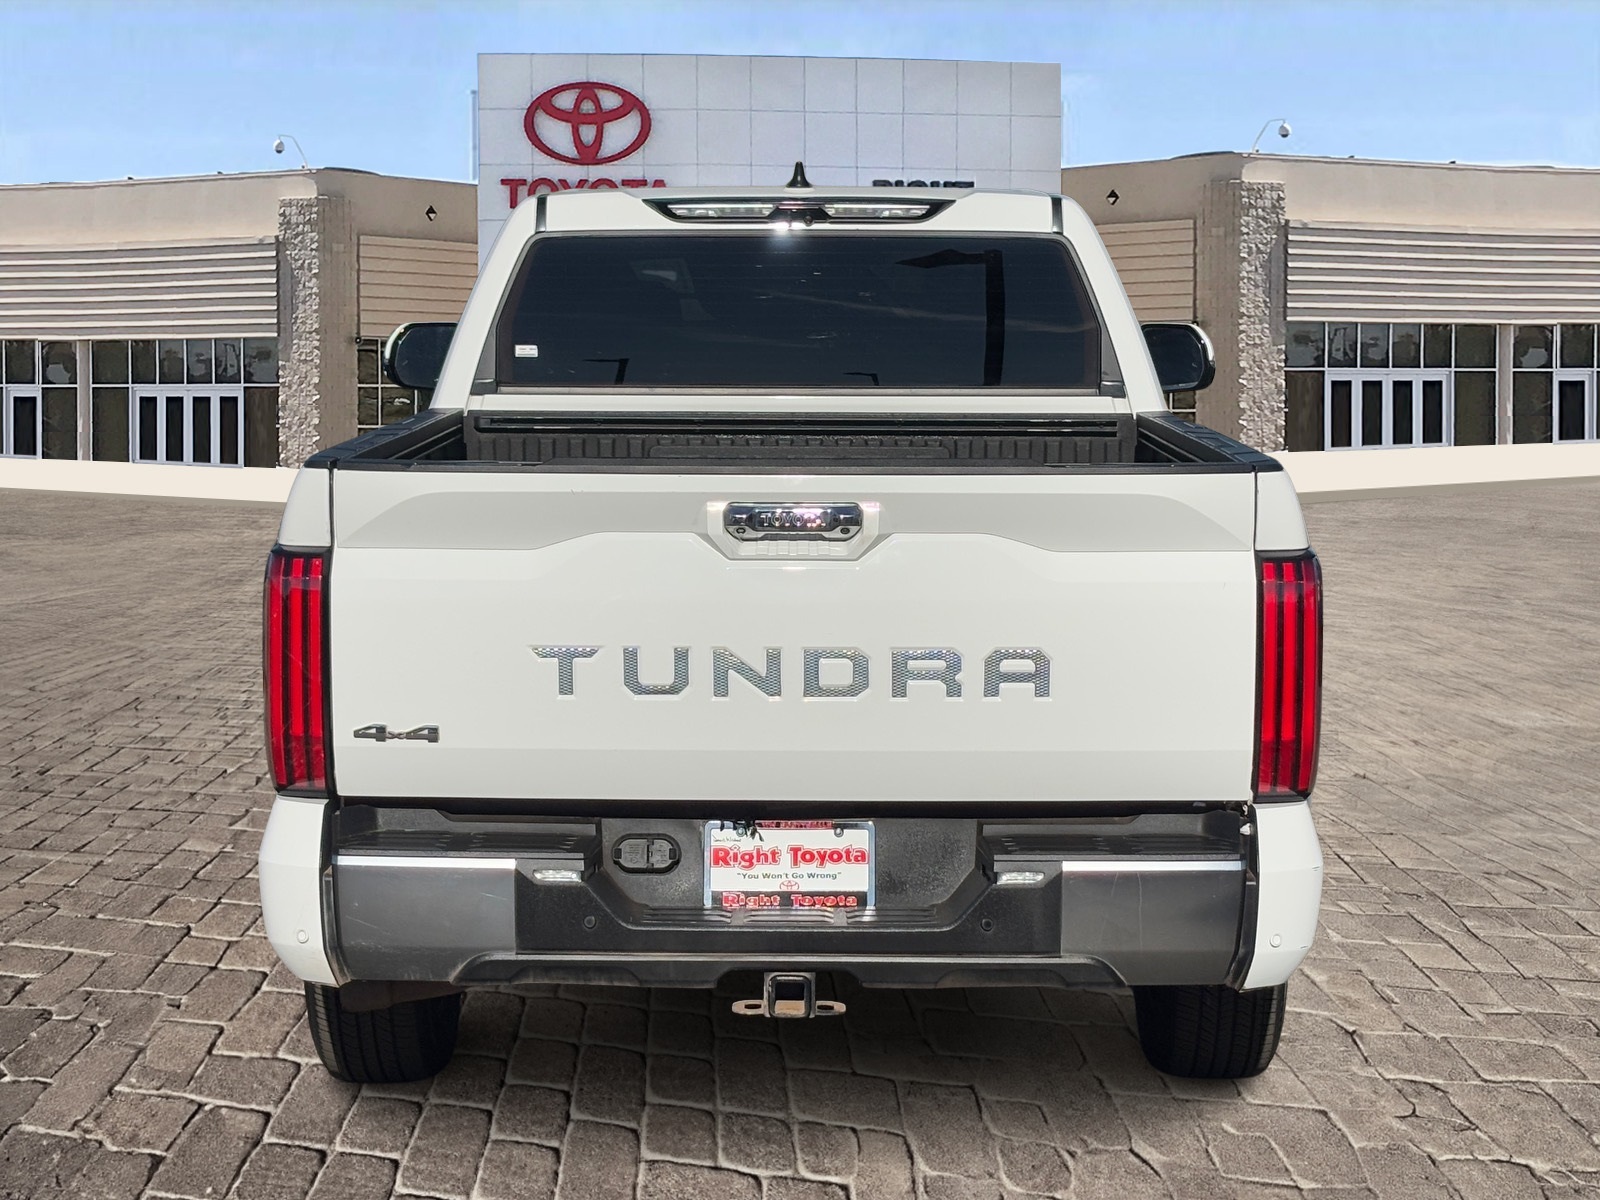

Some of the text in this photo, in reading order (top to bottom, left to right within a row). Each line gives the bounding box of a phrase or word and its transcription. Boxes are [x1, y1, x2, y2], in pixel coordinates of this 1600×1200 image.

[530, 646, 1053, 699] TUNDRA
[711, 845, 869, 870] Right Toyota
[737, 872, 842, 881] "You Won't Go Wrong"
[722, 892, 858, 908] Right Toyota
